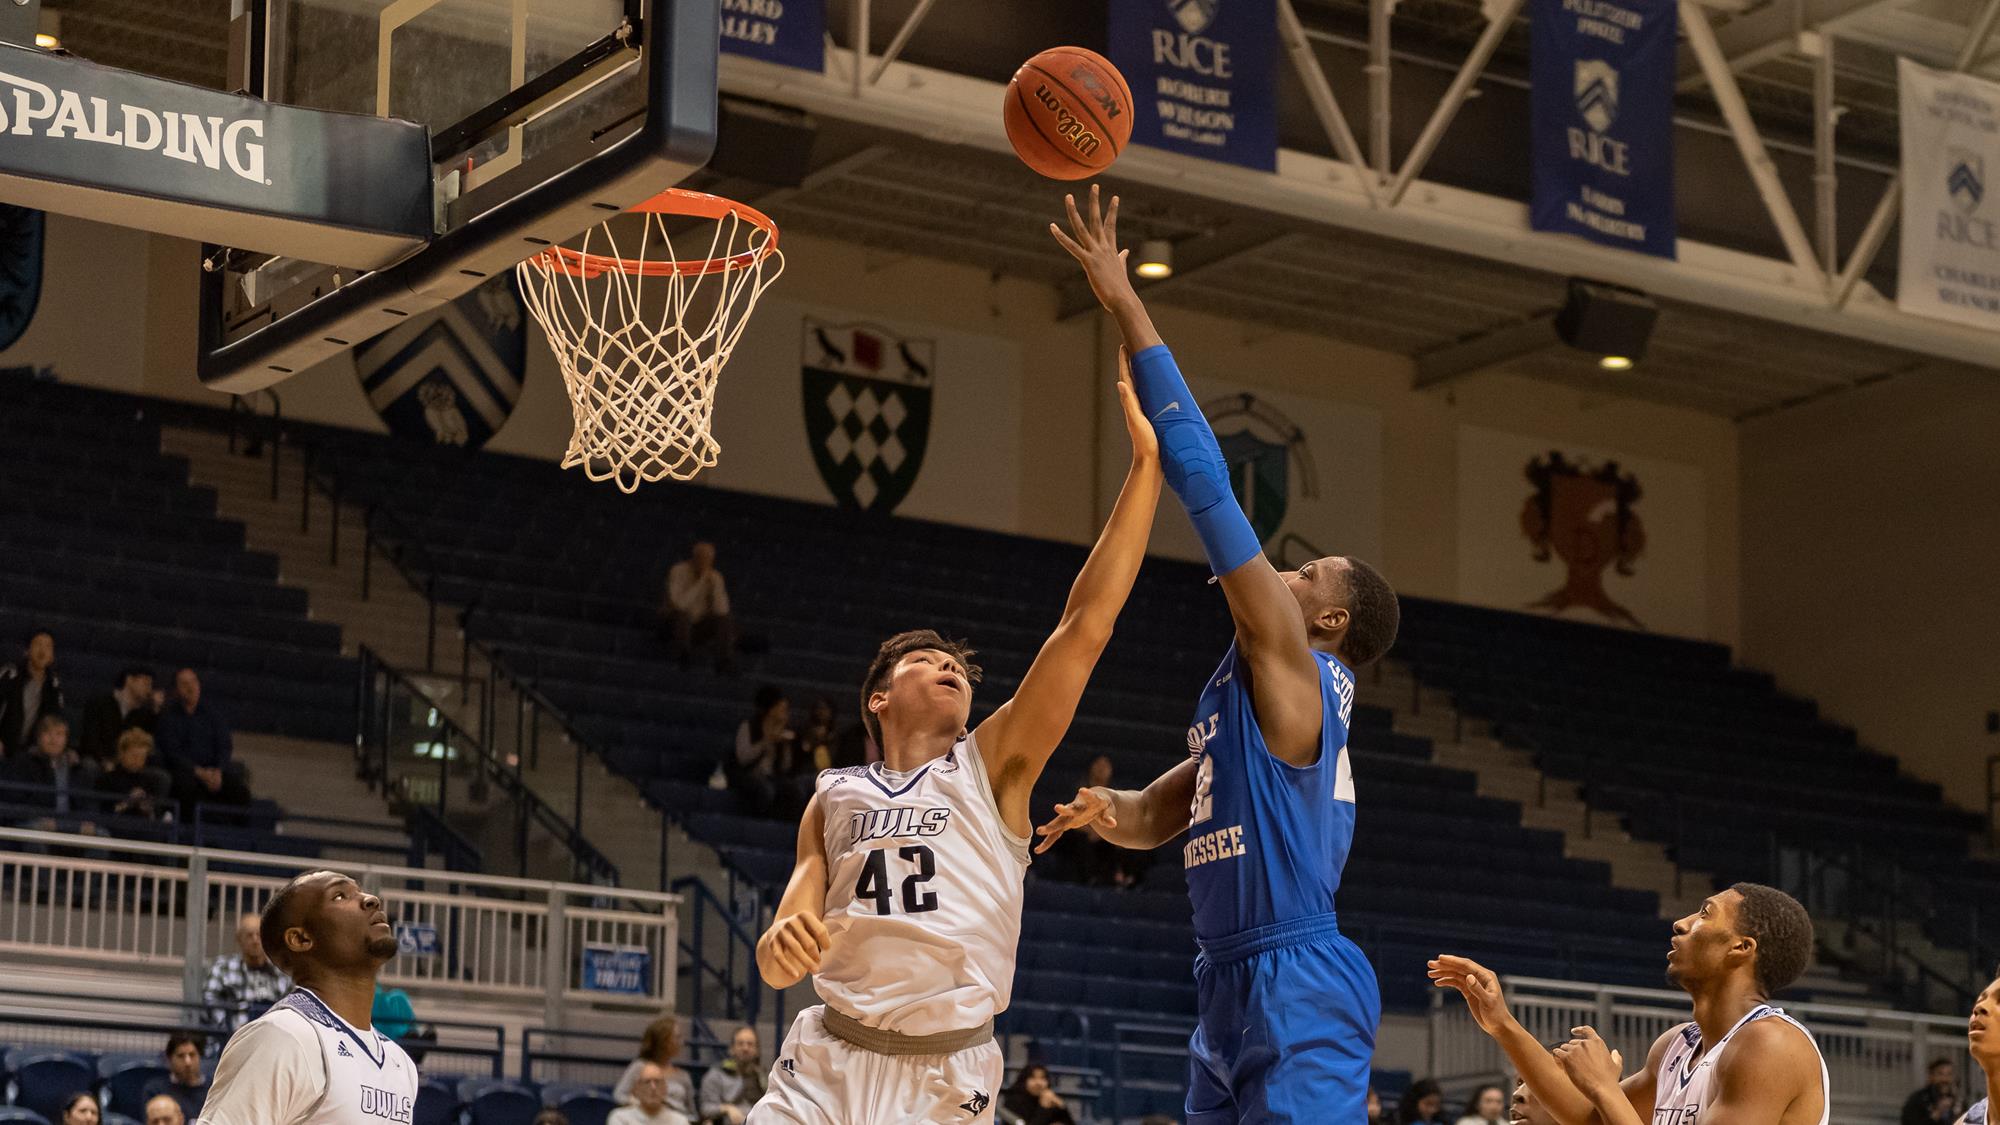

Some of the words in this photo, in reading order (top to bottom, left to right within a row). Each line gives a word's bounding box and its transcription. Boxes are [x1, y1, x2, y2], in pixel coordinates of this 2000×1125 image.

[720, 17, 778, 45] LLEY
[1152, 28, 1233, 78] RICE
[1034, 83, 1101, 158] Wilson
[1568, 127, 1631, 175] RICE
[850, 808, 951, 846] OWLS
[855, 845, 939, 916] 42
[361, 1084, 413, 1124] OWLS
